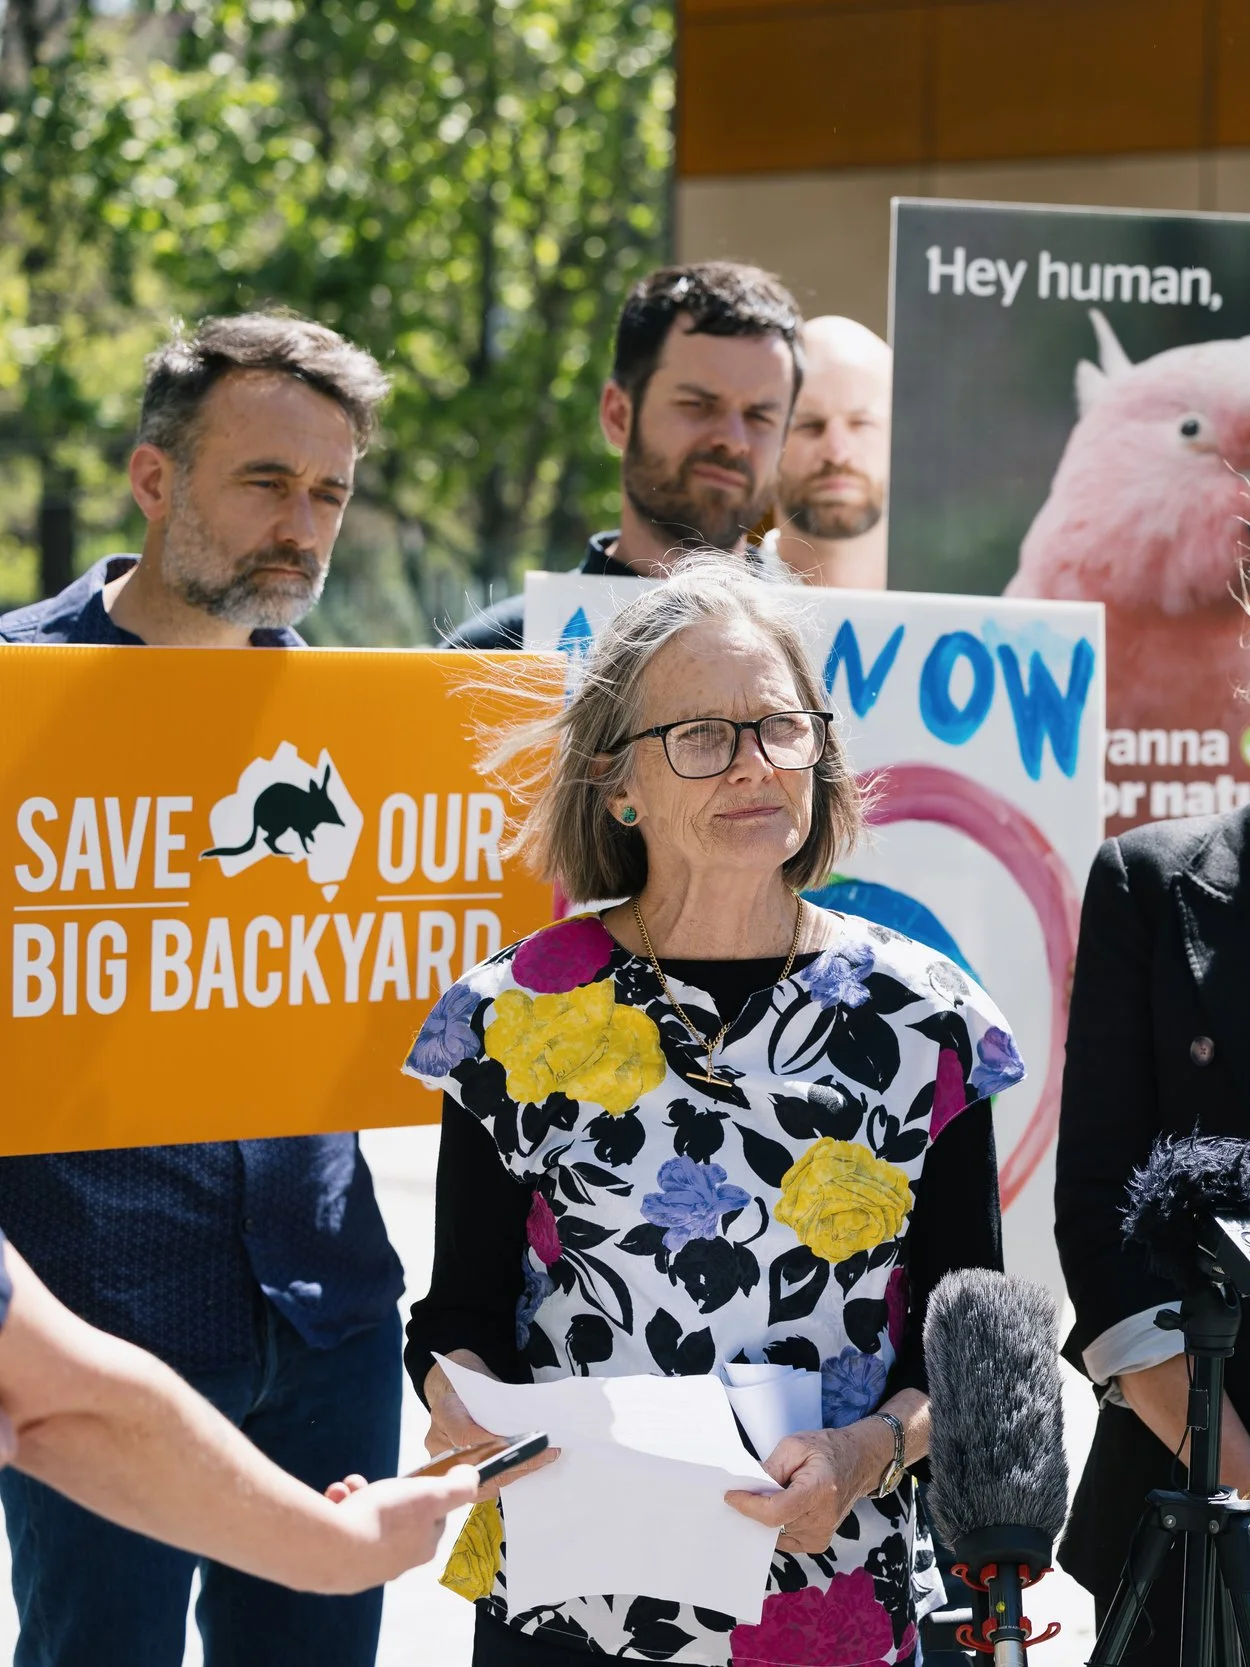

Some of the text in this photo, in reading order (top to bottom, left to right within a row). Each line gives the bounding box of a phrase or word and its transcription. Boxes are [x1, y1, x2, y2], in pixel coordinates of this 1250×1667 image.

[926, 246, 1222, 312] Hey human,
[823, 619, 1096, 782] NOW
[1105, 729, 1230, 766] anna
[14, 793, 504, 893] SAVE OUR
[13, 909, 501, 1018] BIG BACKYARD
